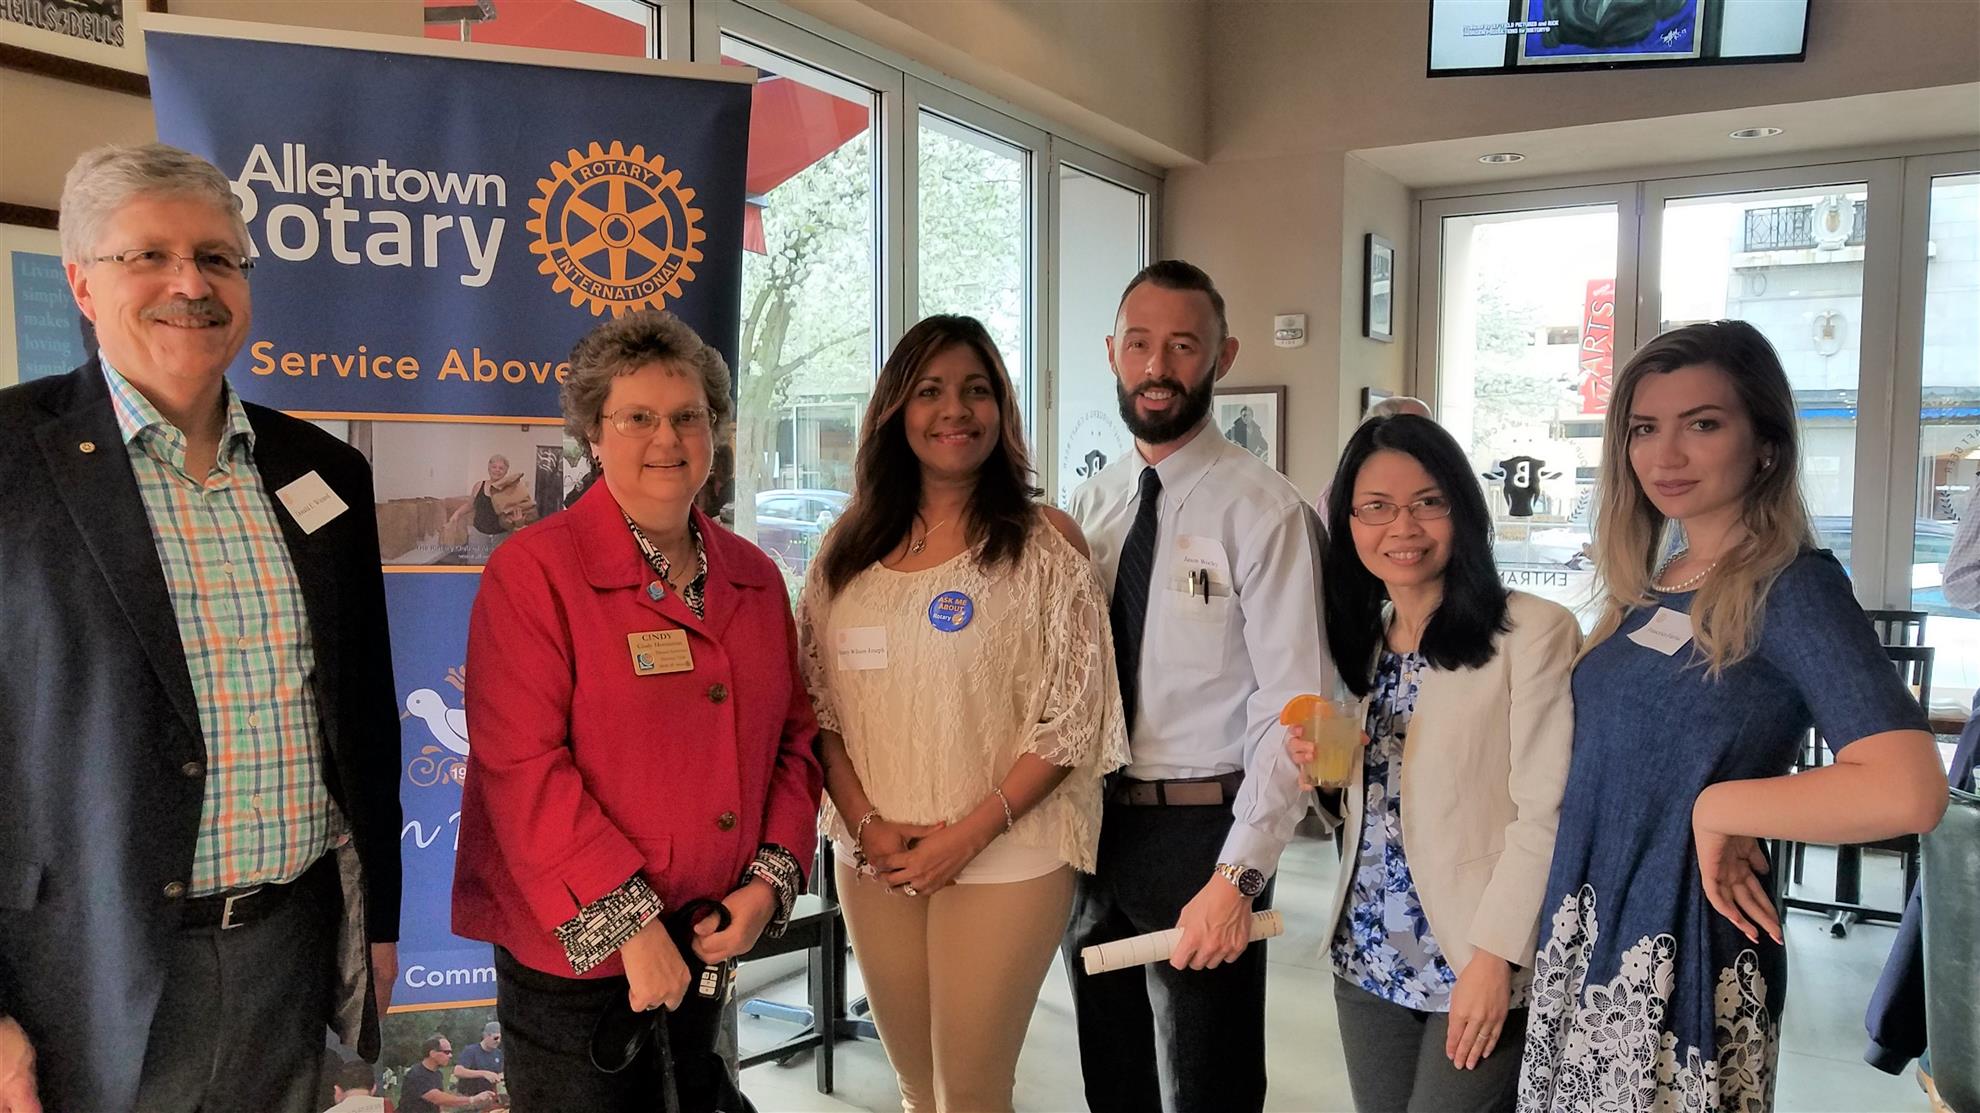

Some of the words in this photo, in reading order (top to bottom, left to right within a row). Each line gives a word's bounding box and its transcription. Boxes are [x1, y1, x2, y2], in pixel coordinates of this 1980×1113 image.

[67, 7, 125, 48] BELLS
[238, 142, 507, 207] Allentown
[579, 160, 654, 183] ROTARY
[556, 255, 681, 300] INTERNATIONAL
[22, 287, 70, 309] simply
[24, 312, 71, 329] makes
[25, 334, 72, 357] loving
[250, 341, 420, 380] Service
[437, 347, 571, 384] Above
[932, 612, 952, 621] Rotary
[938, 603, 965, 612] ABOUT
[641, 632, 672, 641] CINDY
[452, 767, 467, 780] 19
[405, 964, 497, 988] Comm
